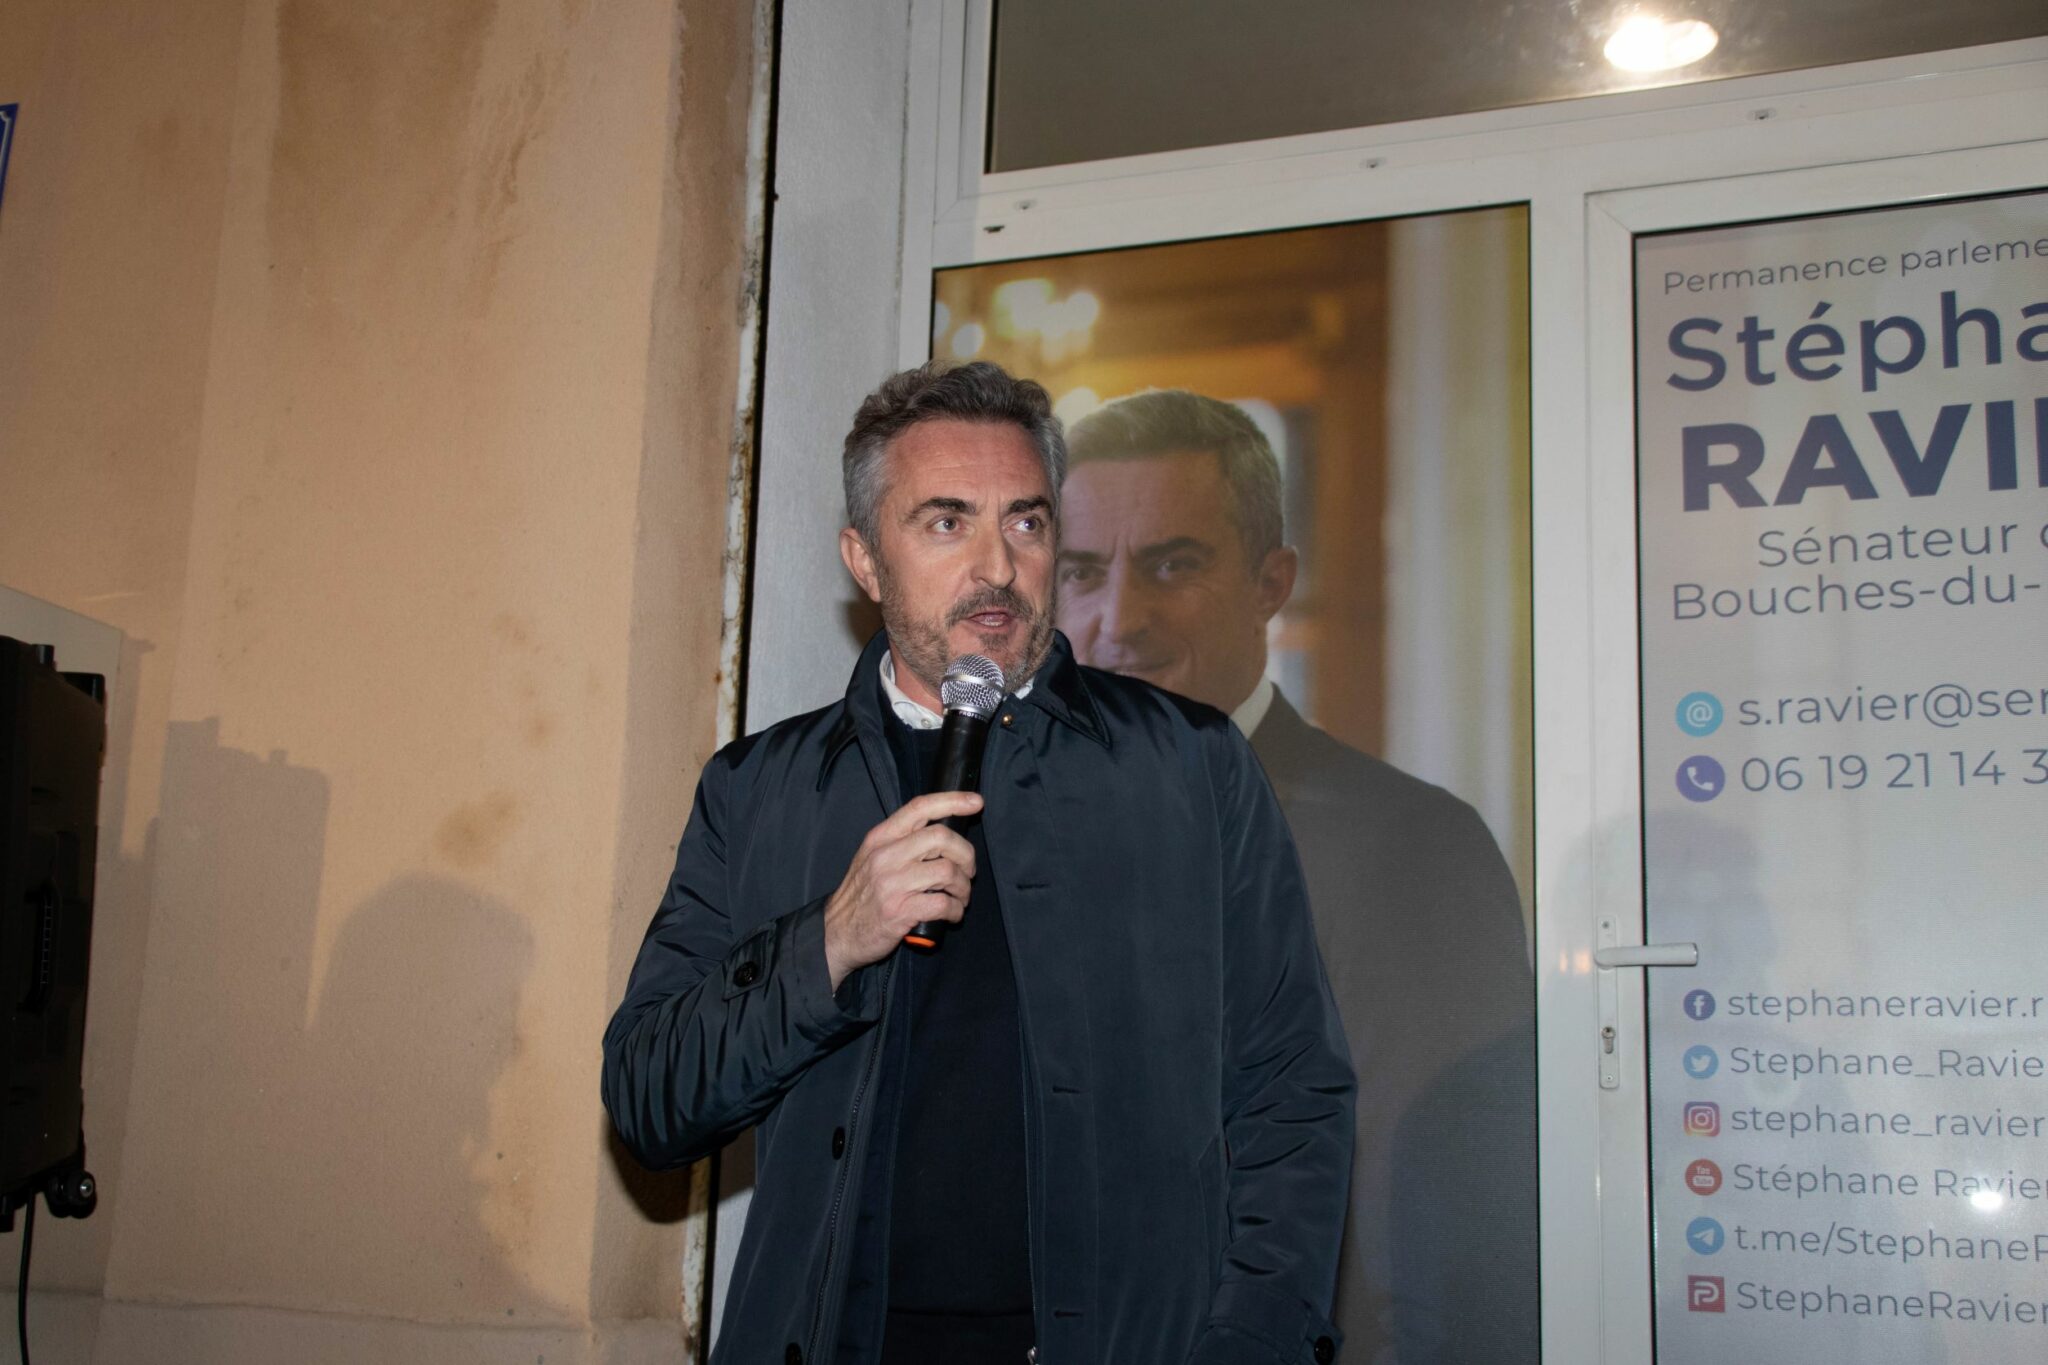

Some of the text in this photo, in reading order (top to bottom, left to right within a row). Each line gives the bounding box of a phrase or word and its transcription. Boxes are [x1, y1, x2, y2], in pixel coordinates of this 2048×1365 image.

[1665, 238, 2048, 294] Permanence parleme
[1666, 290, 2048, 392] Stépha
[1682, 398, 2048, 511] RAVI
[1759, 524, 2018, 570] Sénateur
[1674, 564, 2040, 620] Bouches-du-
[1742, 749, 2048, 792] 06 19 21 14 3
[1729, 989, 2043, 1023] stephaneravier.r
[1731, 1047, 2044, 1080] Stephane_Ravie
[1732, 1105, 2045, 1138] stephane_ravier
[1734, 1164, 2048, 1200] Stéphane Ravie
